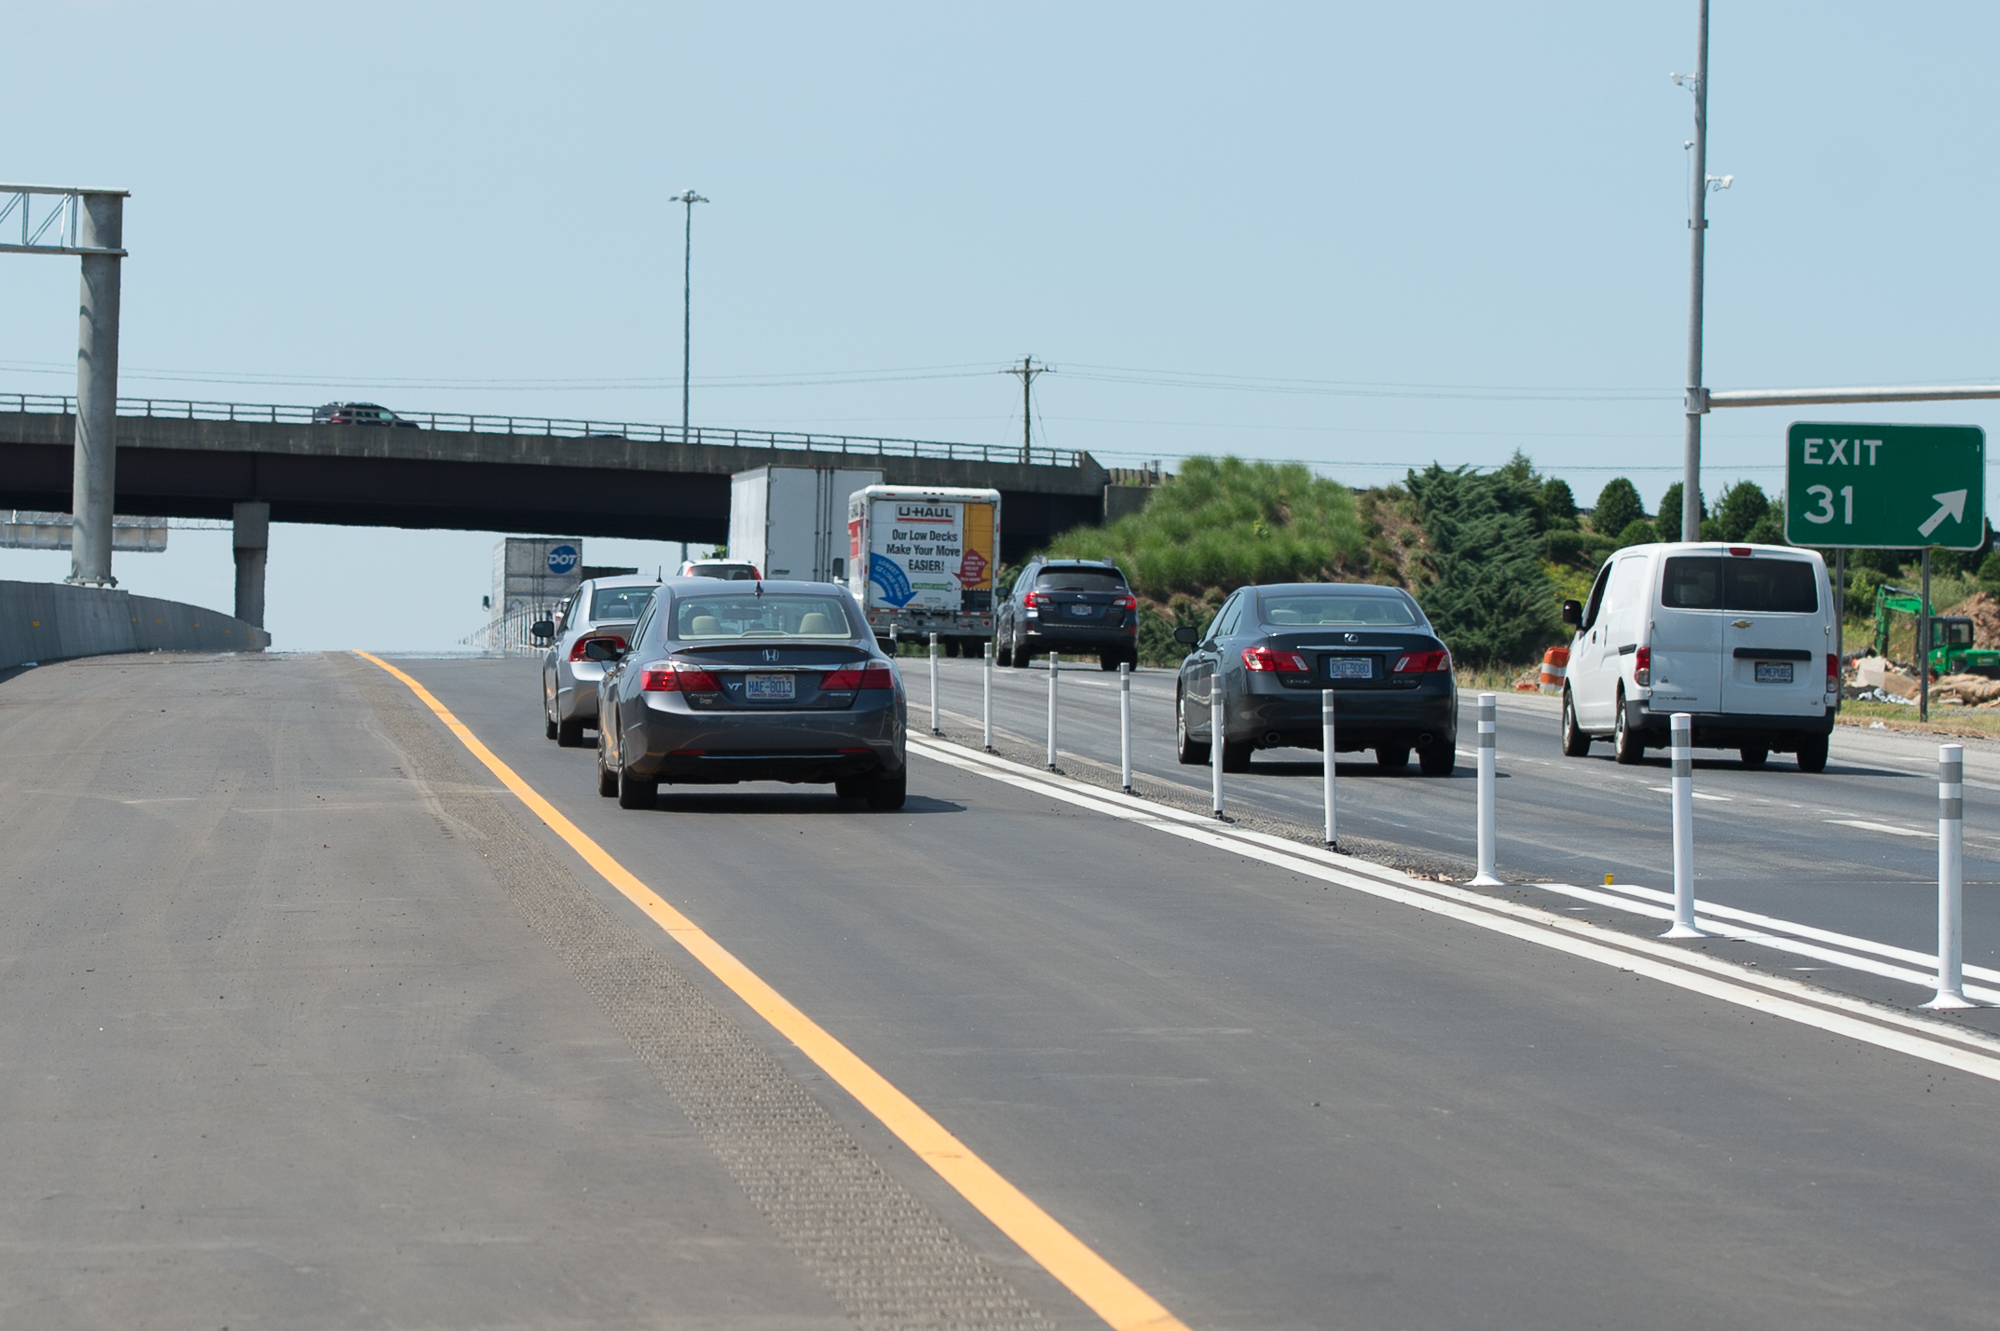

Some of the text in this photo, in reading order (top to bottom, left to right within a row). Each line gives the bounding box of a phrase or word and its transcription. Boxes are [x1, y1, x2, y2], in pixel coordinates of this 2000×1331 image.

[1804, 438, 1883, 466] EXIT
[1803, 484, 1853, 525] 31
[898, 506, 953, 518] U-HAUL
[892, 529, 958, 542] Our Low Decks
[886, 544, 961, 557] Make Your Move
[548, 554, 577, 565] DOT
[908, 559, 945, 571] EASIER!
[727, 683, 743, 691] VT
[748, 681, 793, 693] HAE-8013
